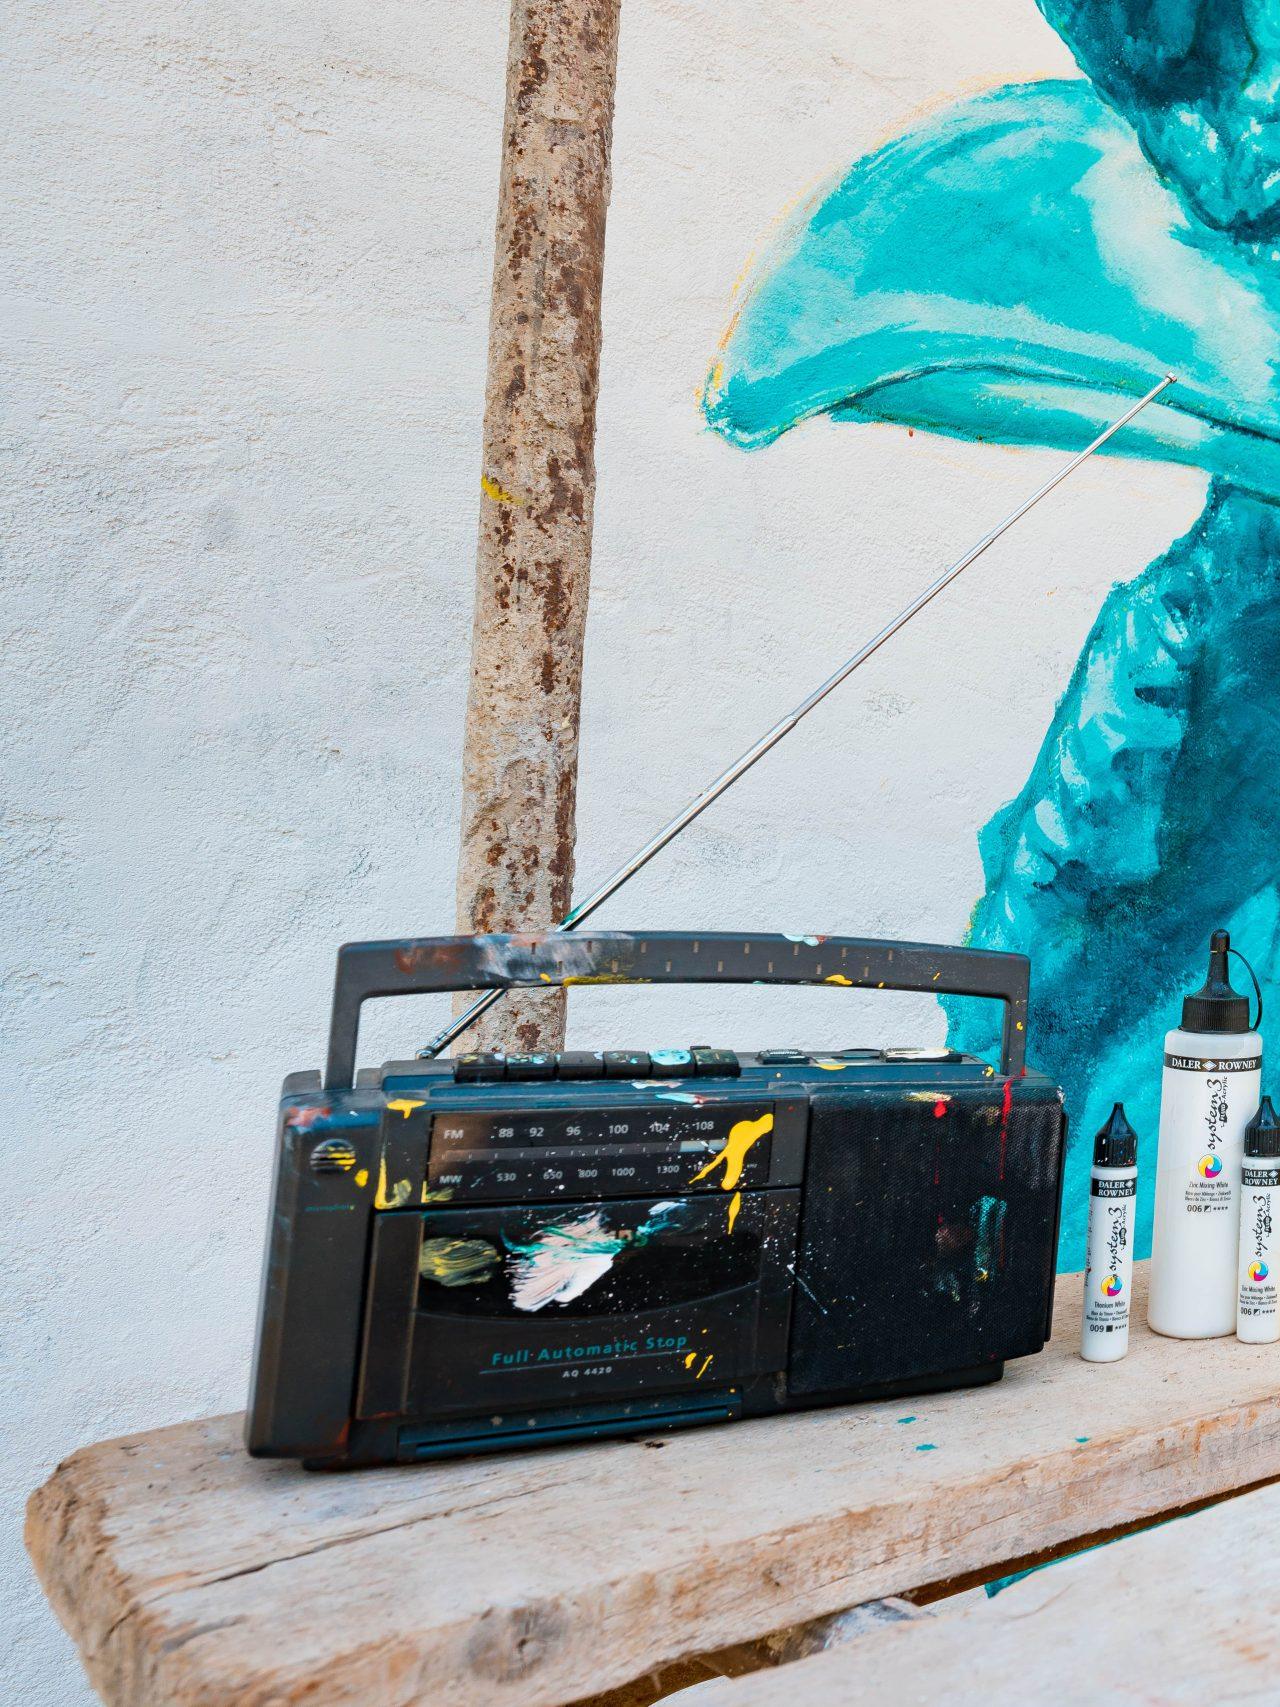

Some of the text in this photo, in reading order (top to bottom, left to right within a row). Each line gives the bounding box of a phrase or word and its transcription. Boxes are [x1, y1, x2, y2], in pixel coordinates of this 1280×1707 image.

[1172, 1057, 1257, 1070] DALER ROWNEY
[443, 1121, 715, 1139] FM 88 92 96 100 104 108
[439, 1174, 463, 1184] MW
[496, 1172, 517, 1182] 530
[543, 1170, 563, 1180] 650
[578, 1169, 598, 1178] 800
[611, 1167, 636, 1177] 1000
[657, 1165, 680, 1174] 1300
[1245, 1170, 1268, 1178] DALER
[1098, 1180, 1125, 1189] DALER
[1244, 1178, 1278, 1186] ROWNEY
[1098, 1187, 1134, 1197] ROWNEY
[1186, 1204, 1203, 1213] 006
[1089, 1323, 1105, 1333] 009
[491, 1336, 688, 1366] Full Automatic Stop
[562, 1365, 613, 1378] AQ 4420
